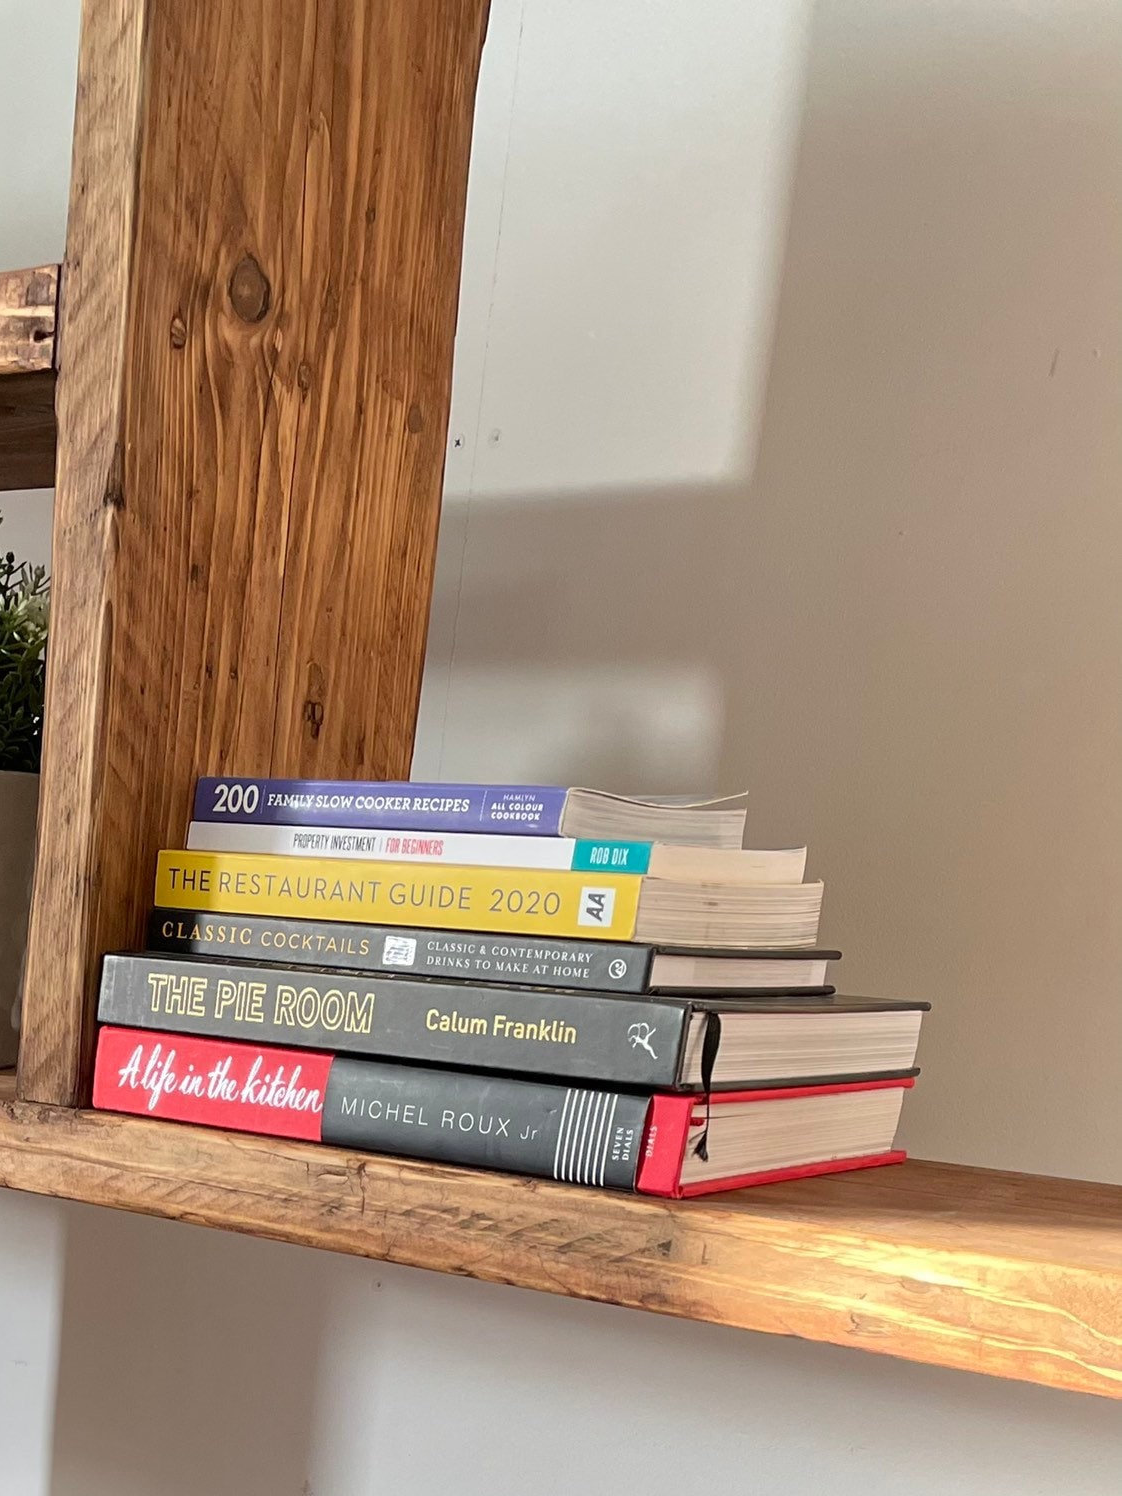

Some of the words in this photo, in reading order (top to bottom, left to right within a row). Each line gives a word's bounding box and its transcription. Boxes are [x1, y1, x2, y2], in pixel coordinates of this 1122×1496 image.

[212, 784, 260, 814] 200
[267, 793, 315, 809] FAMILY
[316, 795, 354, 809] SLOW
[355, 796, 412, 811] COOKER
[412, 797, 470, 812] RECIPES
[491, 802, 506, 811] ALL
[508, 803, 544, 812] COLOUR
[503, 794, 537, 802] HAMLYN
[491, 812, 541, 821] COOKBOOK
[293, 833, 329, 849] PROPERTY
[330, 835, 377, 851] INVESTMENT
[385, 837, 400, 853] FOR
[401, 839, 444, 856] BEGINNERS
[589, 847, 609, 864] ROB
[611, 848, 629, 866] DIX
[168, 867, 211, 892] THE
[218, 872, 382, 904] RESTAURANT
[389, 883, 473, 910] GUIDE
[489, 888, 561, 915] 2020
[586, 893, 606, 922] AA
[162, 921, 252, 945] CLASSIC
[260, 931, 370, 956] COCKTAILS
[427, 941, 476, 954] CLASSIC
[491, 946, 594, 963] CONTEMPORARY
[426, 956, 470, 969] DRINKS
[475, 959, 489, 969] TO
[495, 961, 529, 973] MAKE
[533, 964, 549, 975] AT
[552, 965, 590, 978] HOME
[148, 973, 208, 1017] THE
[214, 979, 267, 1023] PIE
[274, 984, 376, 1034] ROOM
[426, 1009, 488, 1036] Calum
[493, 1015, 578, 1044] Franklin
[118, 1044, 143, 1088] A
[140, 1043, 180, 1111] life
[179, 1064, 205, 1098] in
[207, 1056, 240, 1102] the
[240, 1055, 324, 1113] kitchen
[341, 1096, 429, 1126] MICHEL
[441, 1110, 511, 1137] ROUX
[520, 1125, 538, 1141] Jr
[611, 1126, 624, 1161] SEVEN
[622, 1129, 634, 1161] DIALS
[645, 1126, 658, 1157] DIALS
